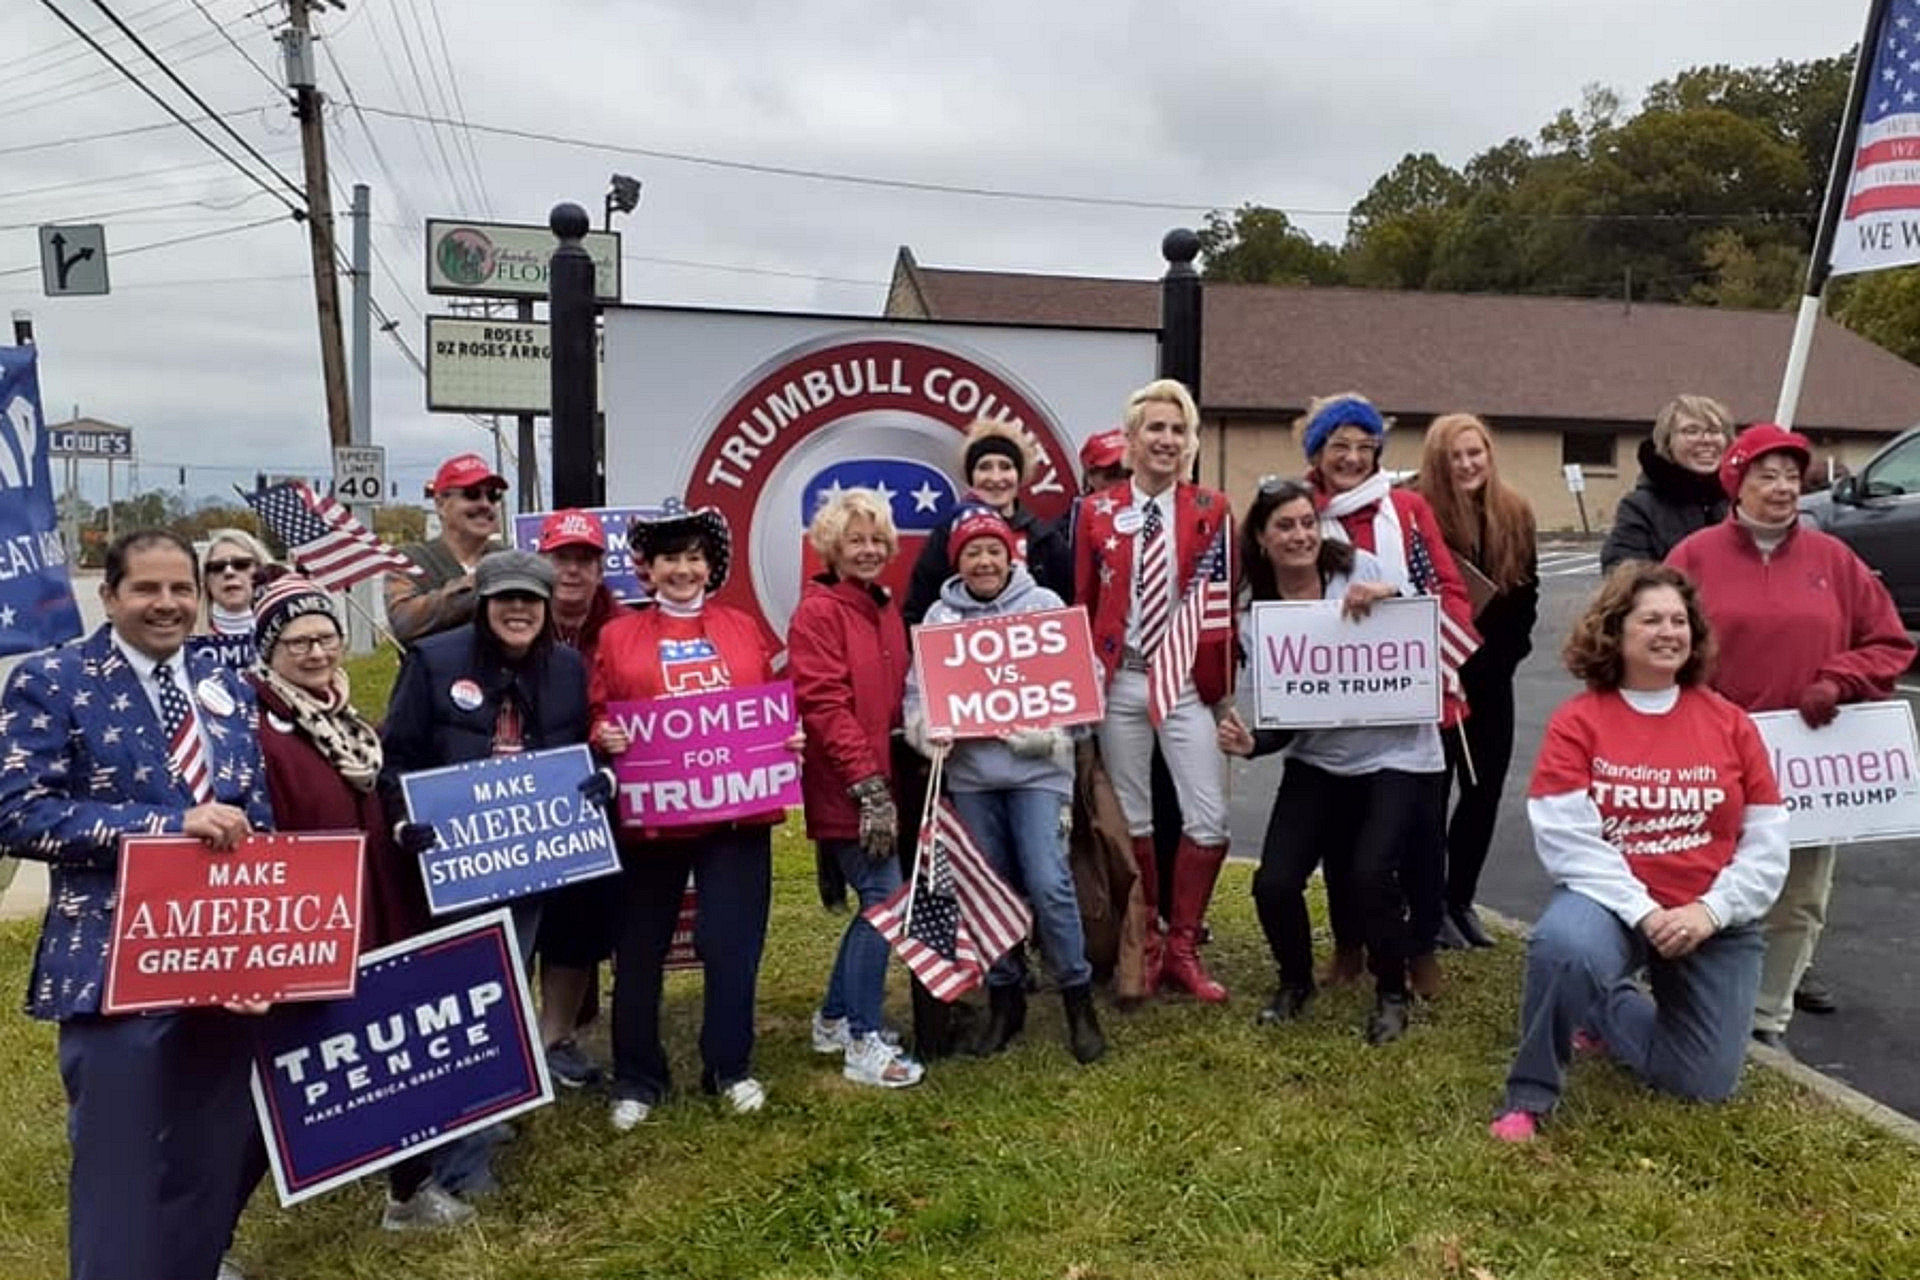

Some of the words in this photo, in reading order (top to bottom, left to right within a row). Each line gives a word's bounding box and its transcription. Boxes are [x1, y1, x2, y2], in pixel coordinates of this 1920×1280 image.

[1859, 221, 1892, 250] WE
[497, 261, 550, 282] FLO
[484, 328, 534, 343] ROSES
[458, 342, 507, 359] ROSES
[707, 358, 912, 490] TRUMBULL
[49, 431, 127, 453] LOWE'S
[340, 451, 379, 462] SPEED
[343, 463, 374, 474] LIMIT
[339, 477, 379, 498] 40
[943, 620, 1068, 667] JOBS
[1266, 633, 1427, 676] Women
[1286, 681, 1330, 695] FOR
[1338, 676, 1412, 694] TRUMP
[948, 680, 1078, 726] MOBS
[617, 693, 791, 743] WOMEN
[683, 746, 731, 770] FOR
[1593, 757, 1671, 785] Standing
[1678, 765, 1717, 782] with
[473, 774, 537, 803] MAKE
[621, 761, 798, 813] TRUMP
[1592, 780, 1726, 812] TRUMP
[1783, 795, 1813, 812] OR
[1821, 787, 1897, 808] TRUMP
[430, 842, 530, 885] STRONG
[534, 827, 607, 862] AGAIN
[209, 861, 287, 887] MAKE
[123, 893, 353, 940] AMERICA
[138, 947, 239, 974] GREAT
[245, 940, 338, 969] AGAIN
[274, 980, 503, 1085] TRUMP
[304, 1023, 490, 1106] PENCE
[303, 1104, 344, 1126] MAKE
[347, 1081, 406, 1110] AMERICA
[408, 1063, 452, 1086] GREAT
